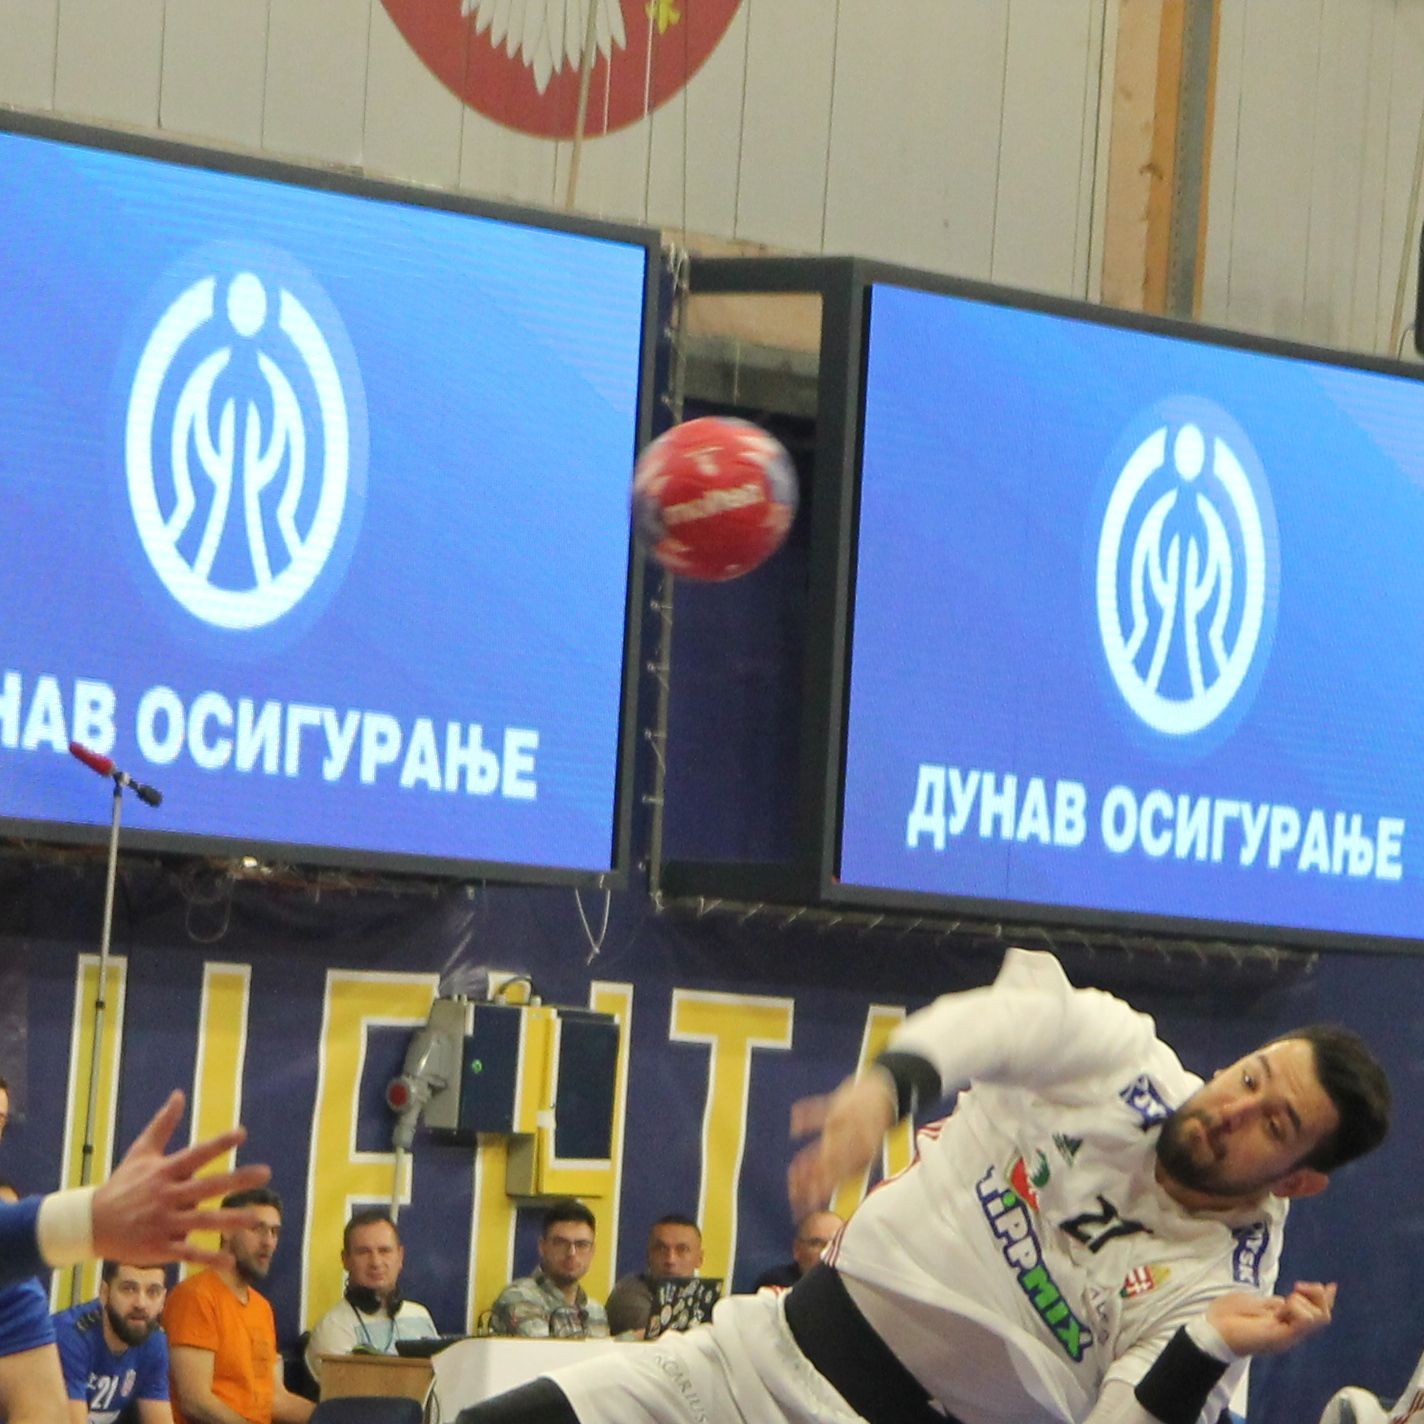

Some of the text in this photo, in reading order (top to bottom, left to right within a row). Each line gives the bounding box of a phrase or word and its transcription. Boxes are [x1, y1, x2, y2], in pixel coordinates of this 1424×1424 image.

[138, 687, 538, 799] ОСИГУРАЊЕ
[908, 766, 1404, 879] ДУНАВ ОСИГУРАЊЕ
[91, 1375, 119, 1409] 21
